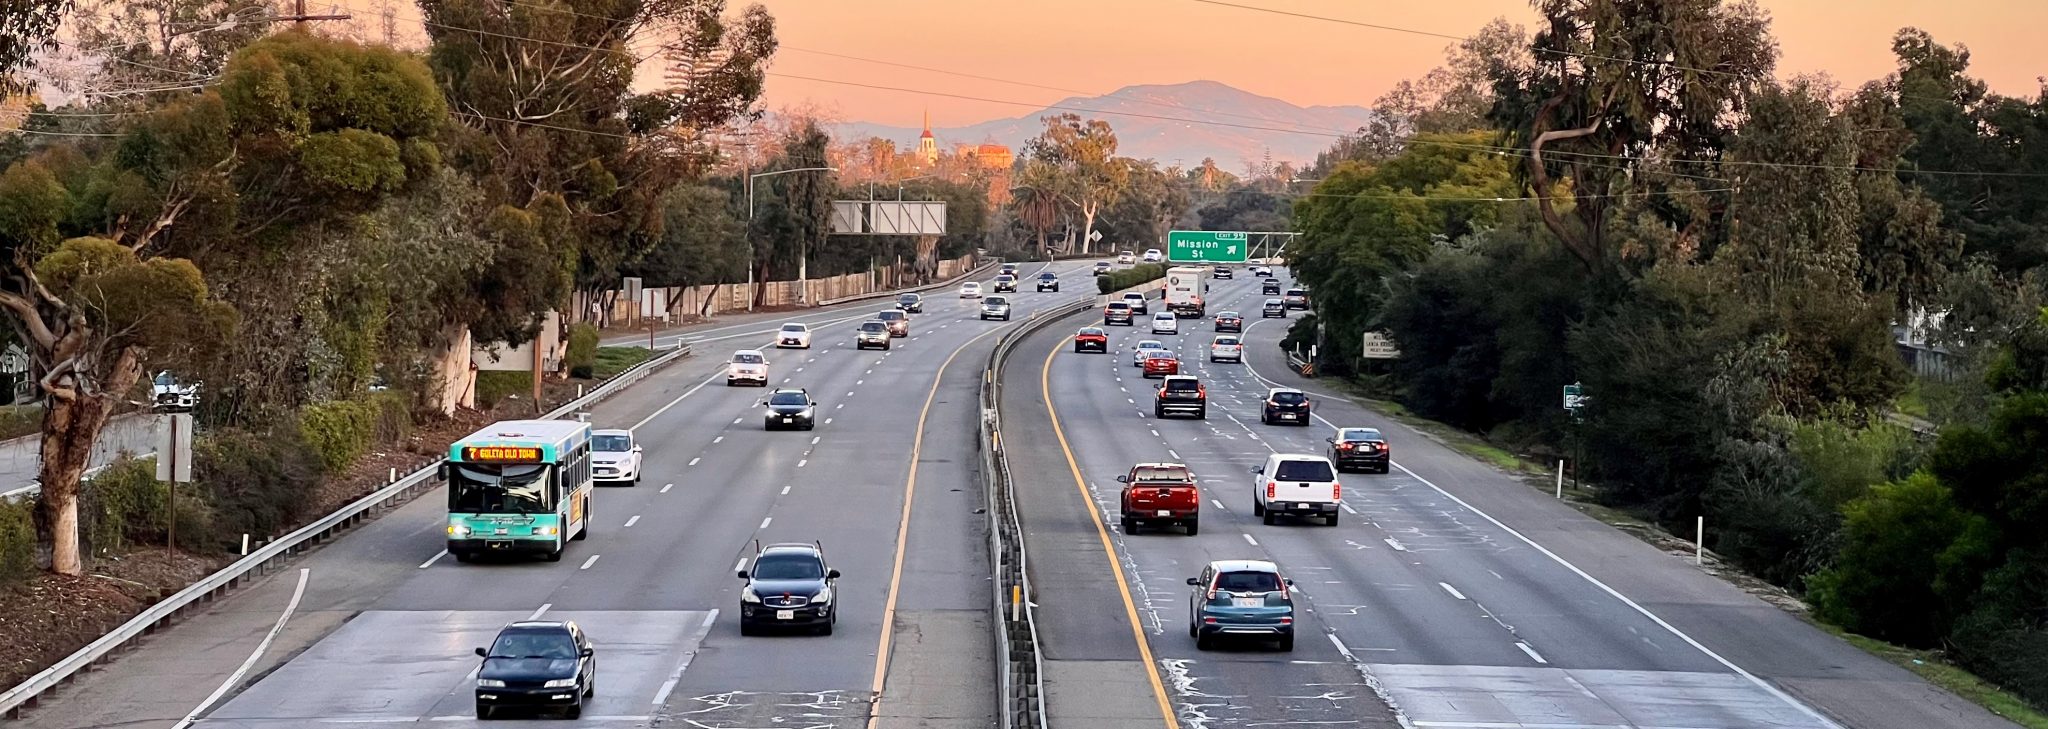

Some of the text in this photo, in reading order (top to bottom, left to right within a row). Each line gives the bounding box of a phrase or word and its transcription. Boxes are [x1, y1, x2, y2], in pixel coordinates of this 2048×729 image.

[1178, 240, 1218, 248] Mission
[1192, 250, 1203, 258] St
[469, 447, 536, 459] 7 GOLETA OLD TOWN
